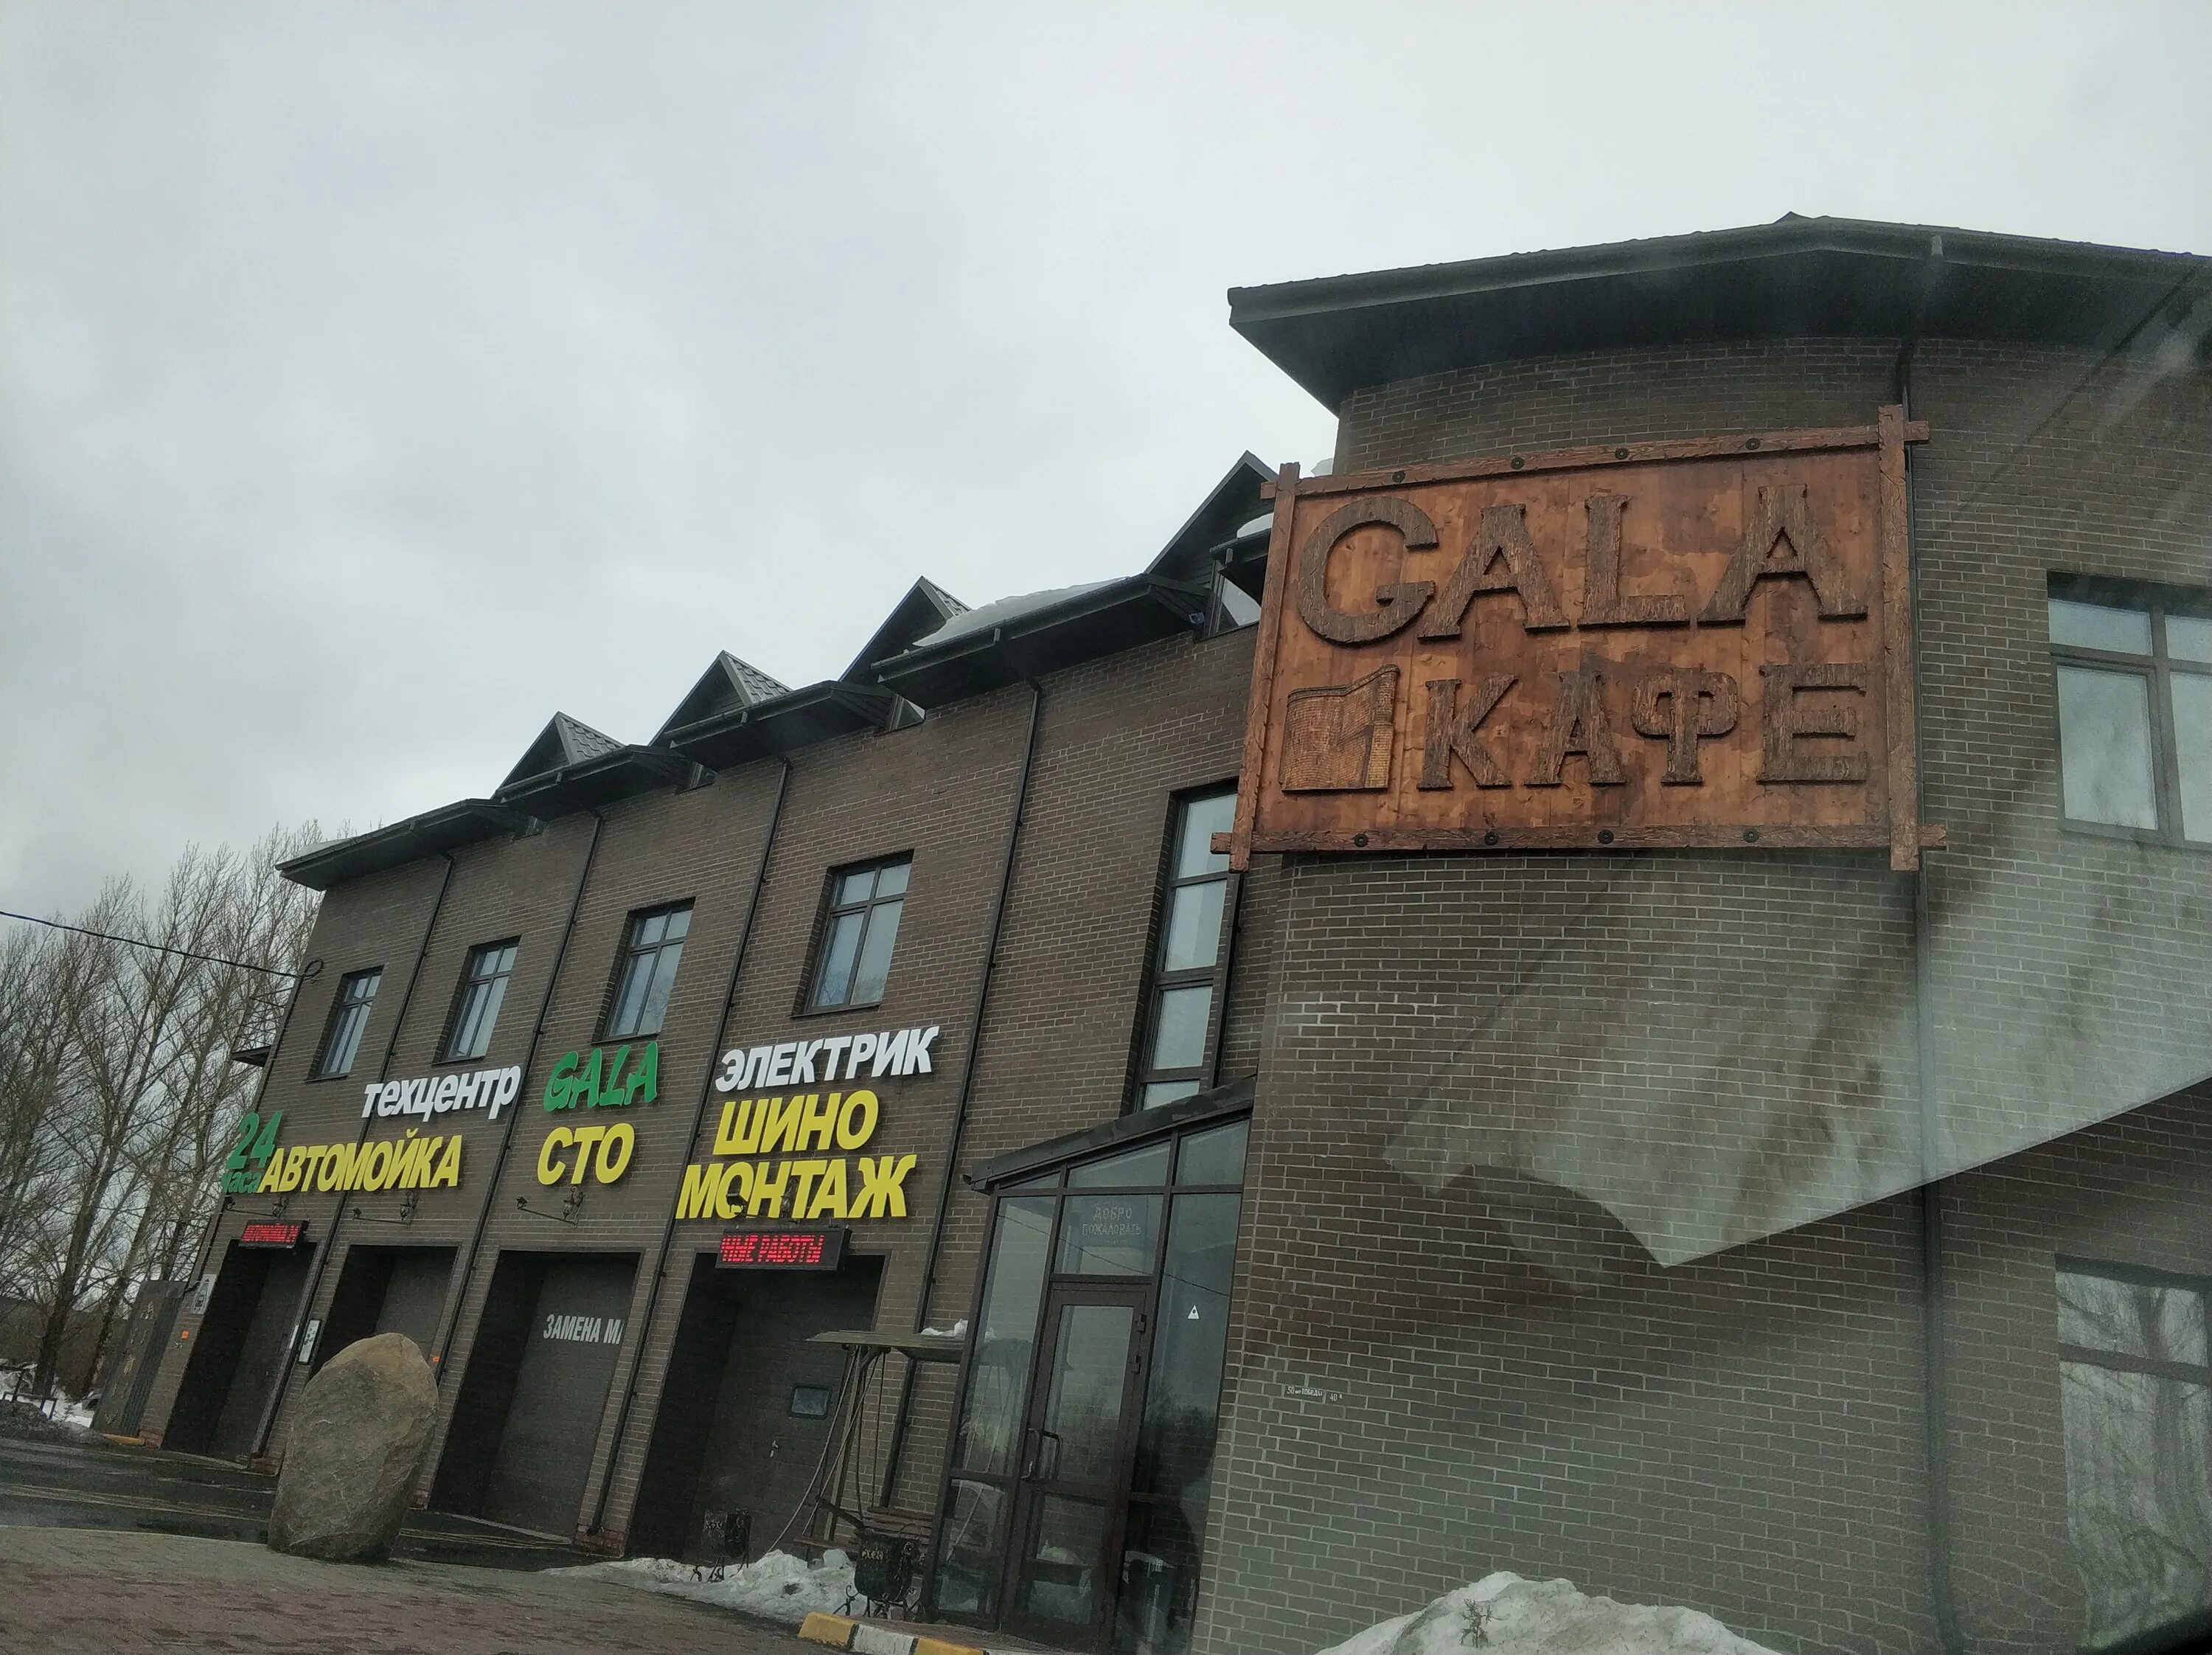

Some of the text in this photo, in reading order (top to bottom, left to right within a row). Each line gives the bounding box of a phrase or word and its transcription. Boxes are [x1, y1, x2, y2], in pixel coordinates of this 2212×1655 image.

[1297, 483, 1868, 647] GALA
[1416, 664, 1868, 791] КАФЕ
[543, 1041, 658, 1112] GALA
[715, 1026, 940, 1092] ЭЛЕКТРИК
[361, 1066, 521, 1123] техцентр
[712, 1090, 879, 1155] ШИНО
[226, 1110, 283, 1169] 24
[257, 1128, 463, 1193] АВТОМОЙКА
[537, 1123, 635, 1185] СТО
[675, 1154, 917, 1219] МОНТАЖ
[543, 1314, 602, 1342] ЗАМЕНА
